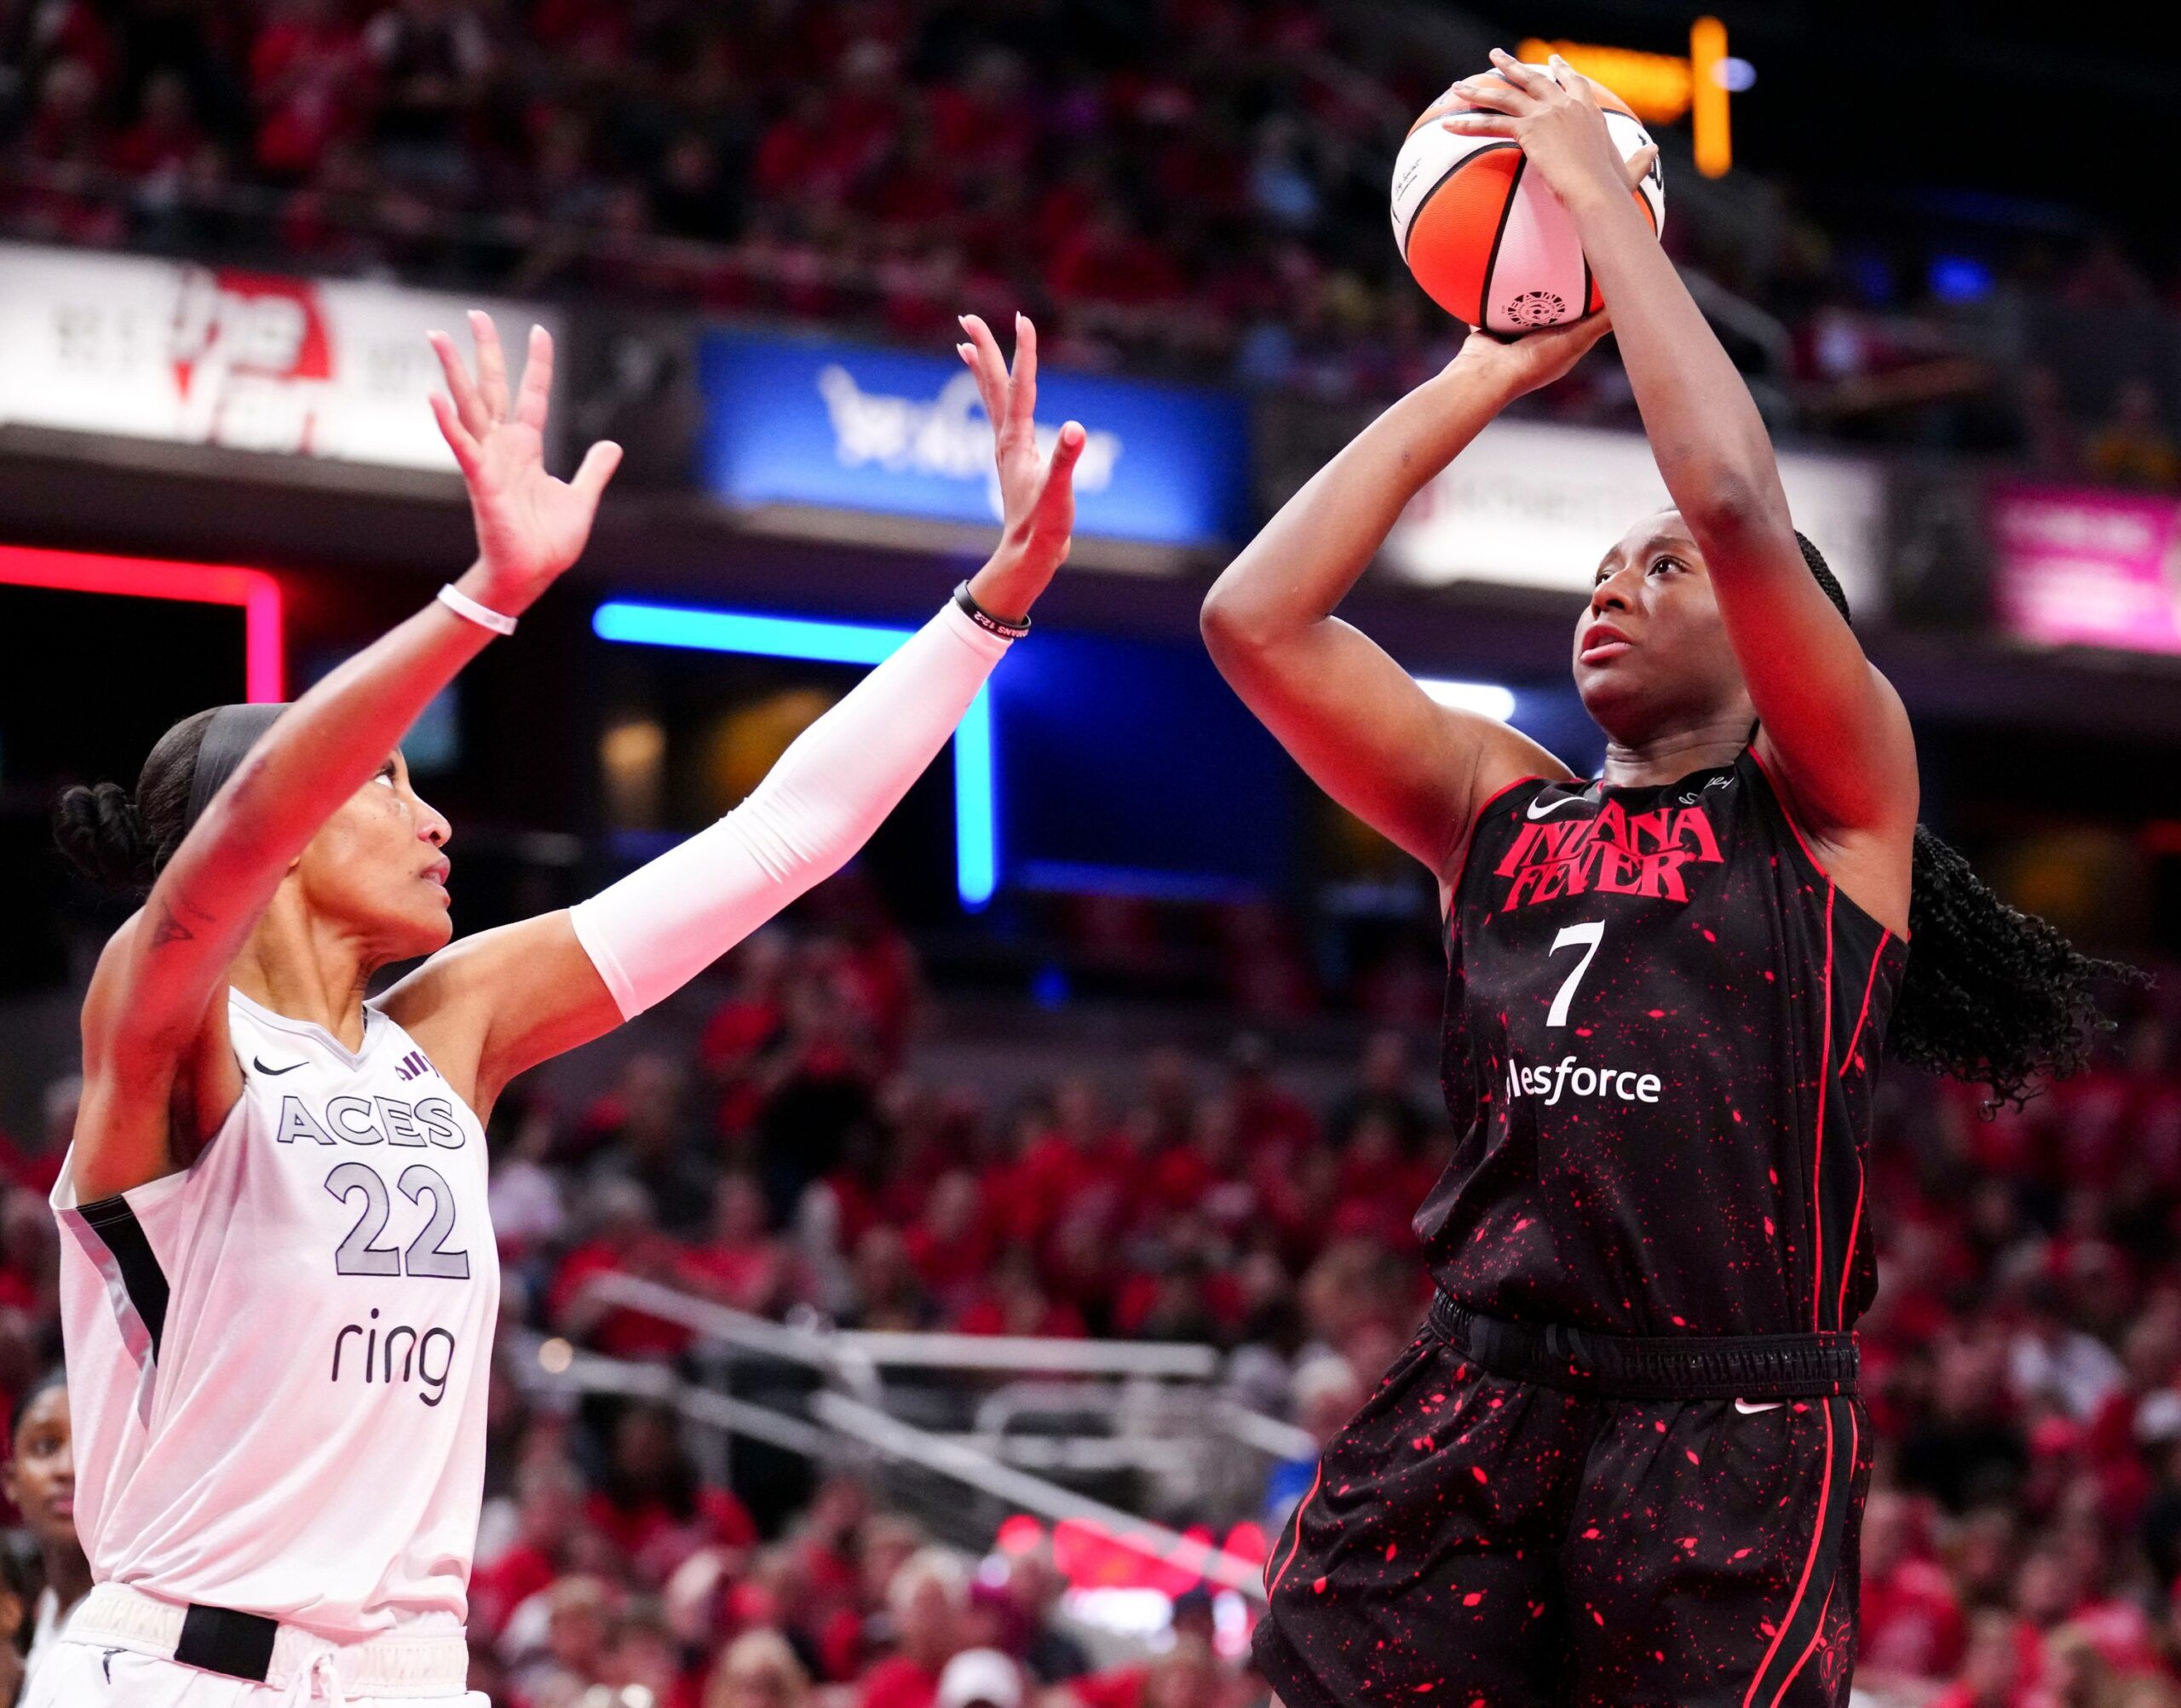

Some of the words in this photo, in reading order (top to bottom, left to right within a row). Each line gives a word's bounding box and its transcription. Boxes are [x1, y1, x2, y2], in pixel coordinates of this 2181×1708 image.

[974, 611, 995, 629] 12:2
[997, 626, 1029, 638] MANS
[1493, 798, 1724, 878] INDANA
[1501, 840, 1690, 912] FEVER
[1546, 919, 1606, 1027] 7
[1506, 1055, 1661, 1106] lesforce
[277, 1096, 465, 1149] ACES
[324, 1162, 469, 1280] 22
[331, 1308, 455, 1407] ring
